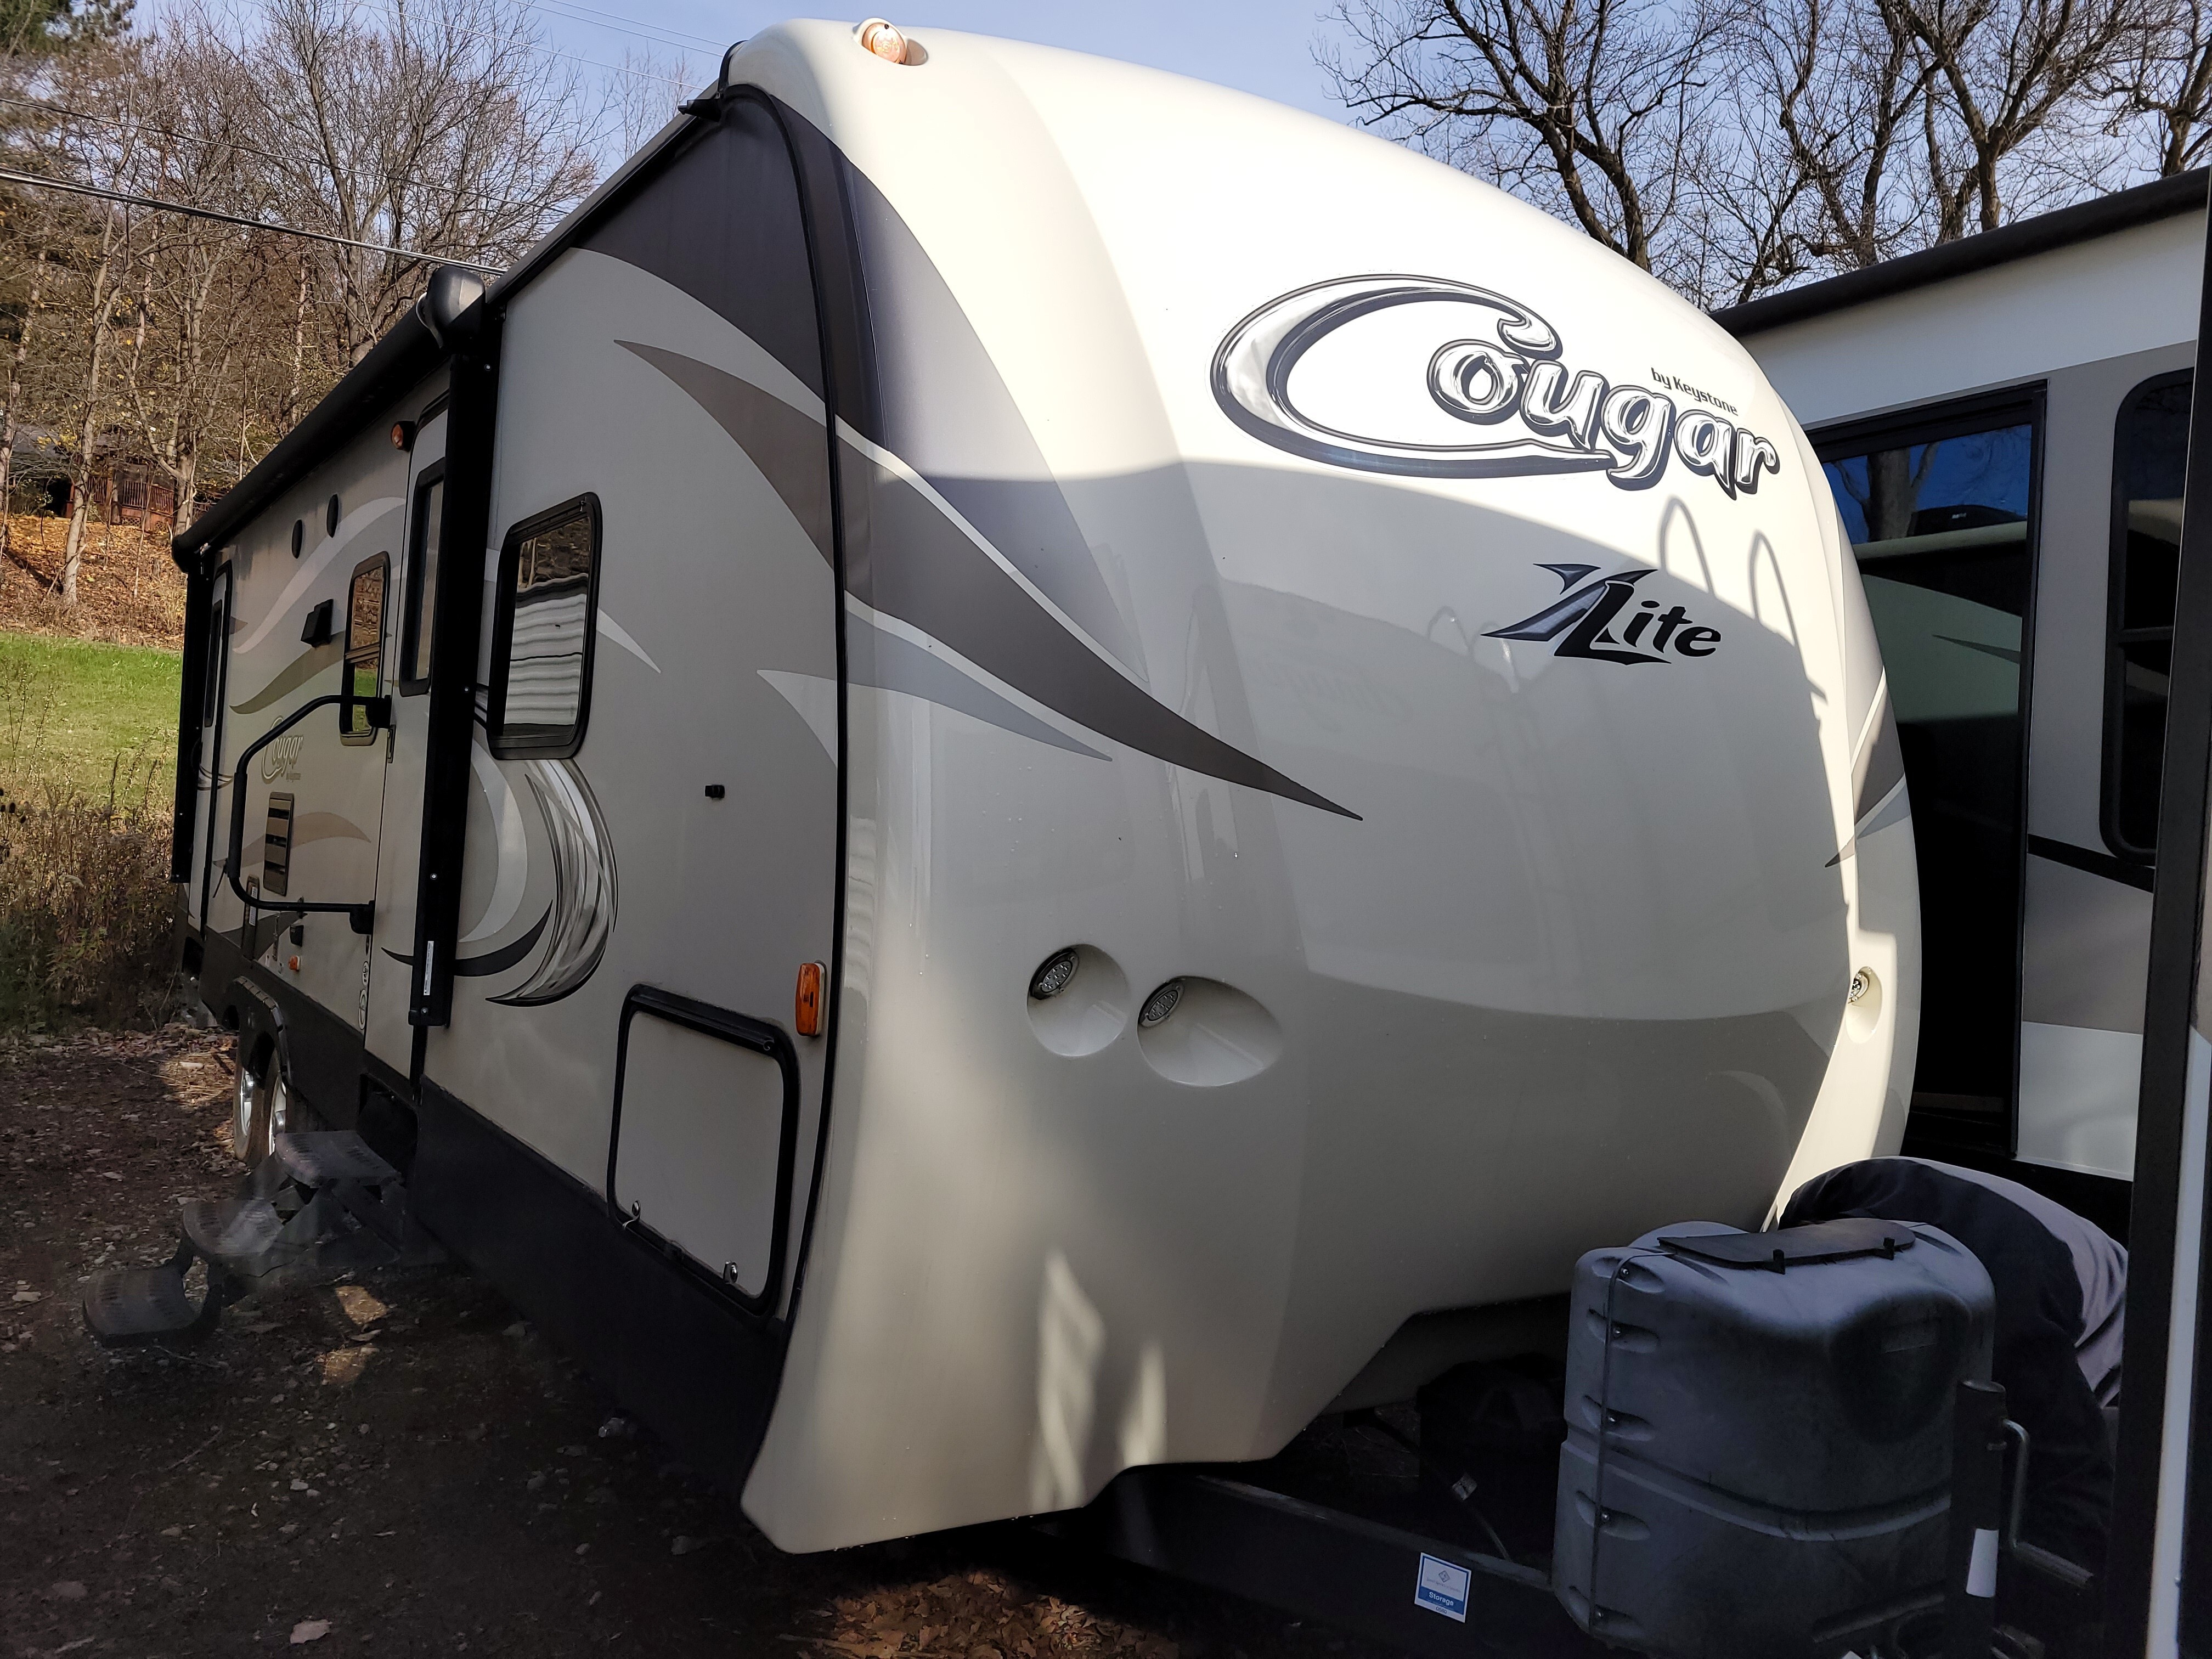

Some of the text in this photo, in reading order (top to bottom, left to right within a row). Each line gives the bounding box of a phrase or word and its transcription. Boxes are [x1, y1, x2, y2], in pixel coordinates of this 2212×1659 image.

[1210, 273, 1780, 500] Cougar
[1651, 367, 1739, 416] by Keystone
[261, 715, 303, 785] Cougar
[1429, 1592, 1454, 1606] Storage
